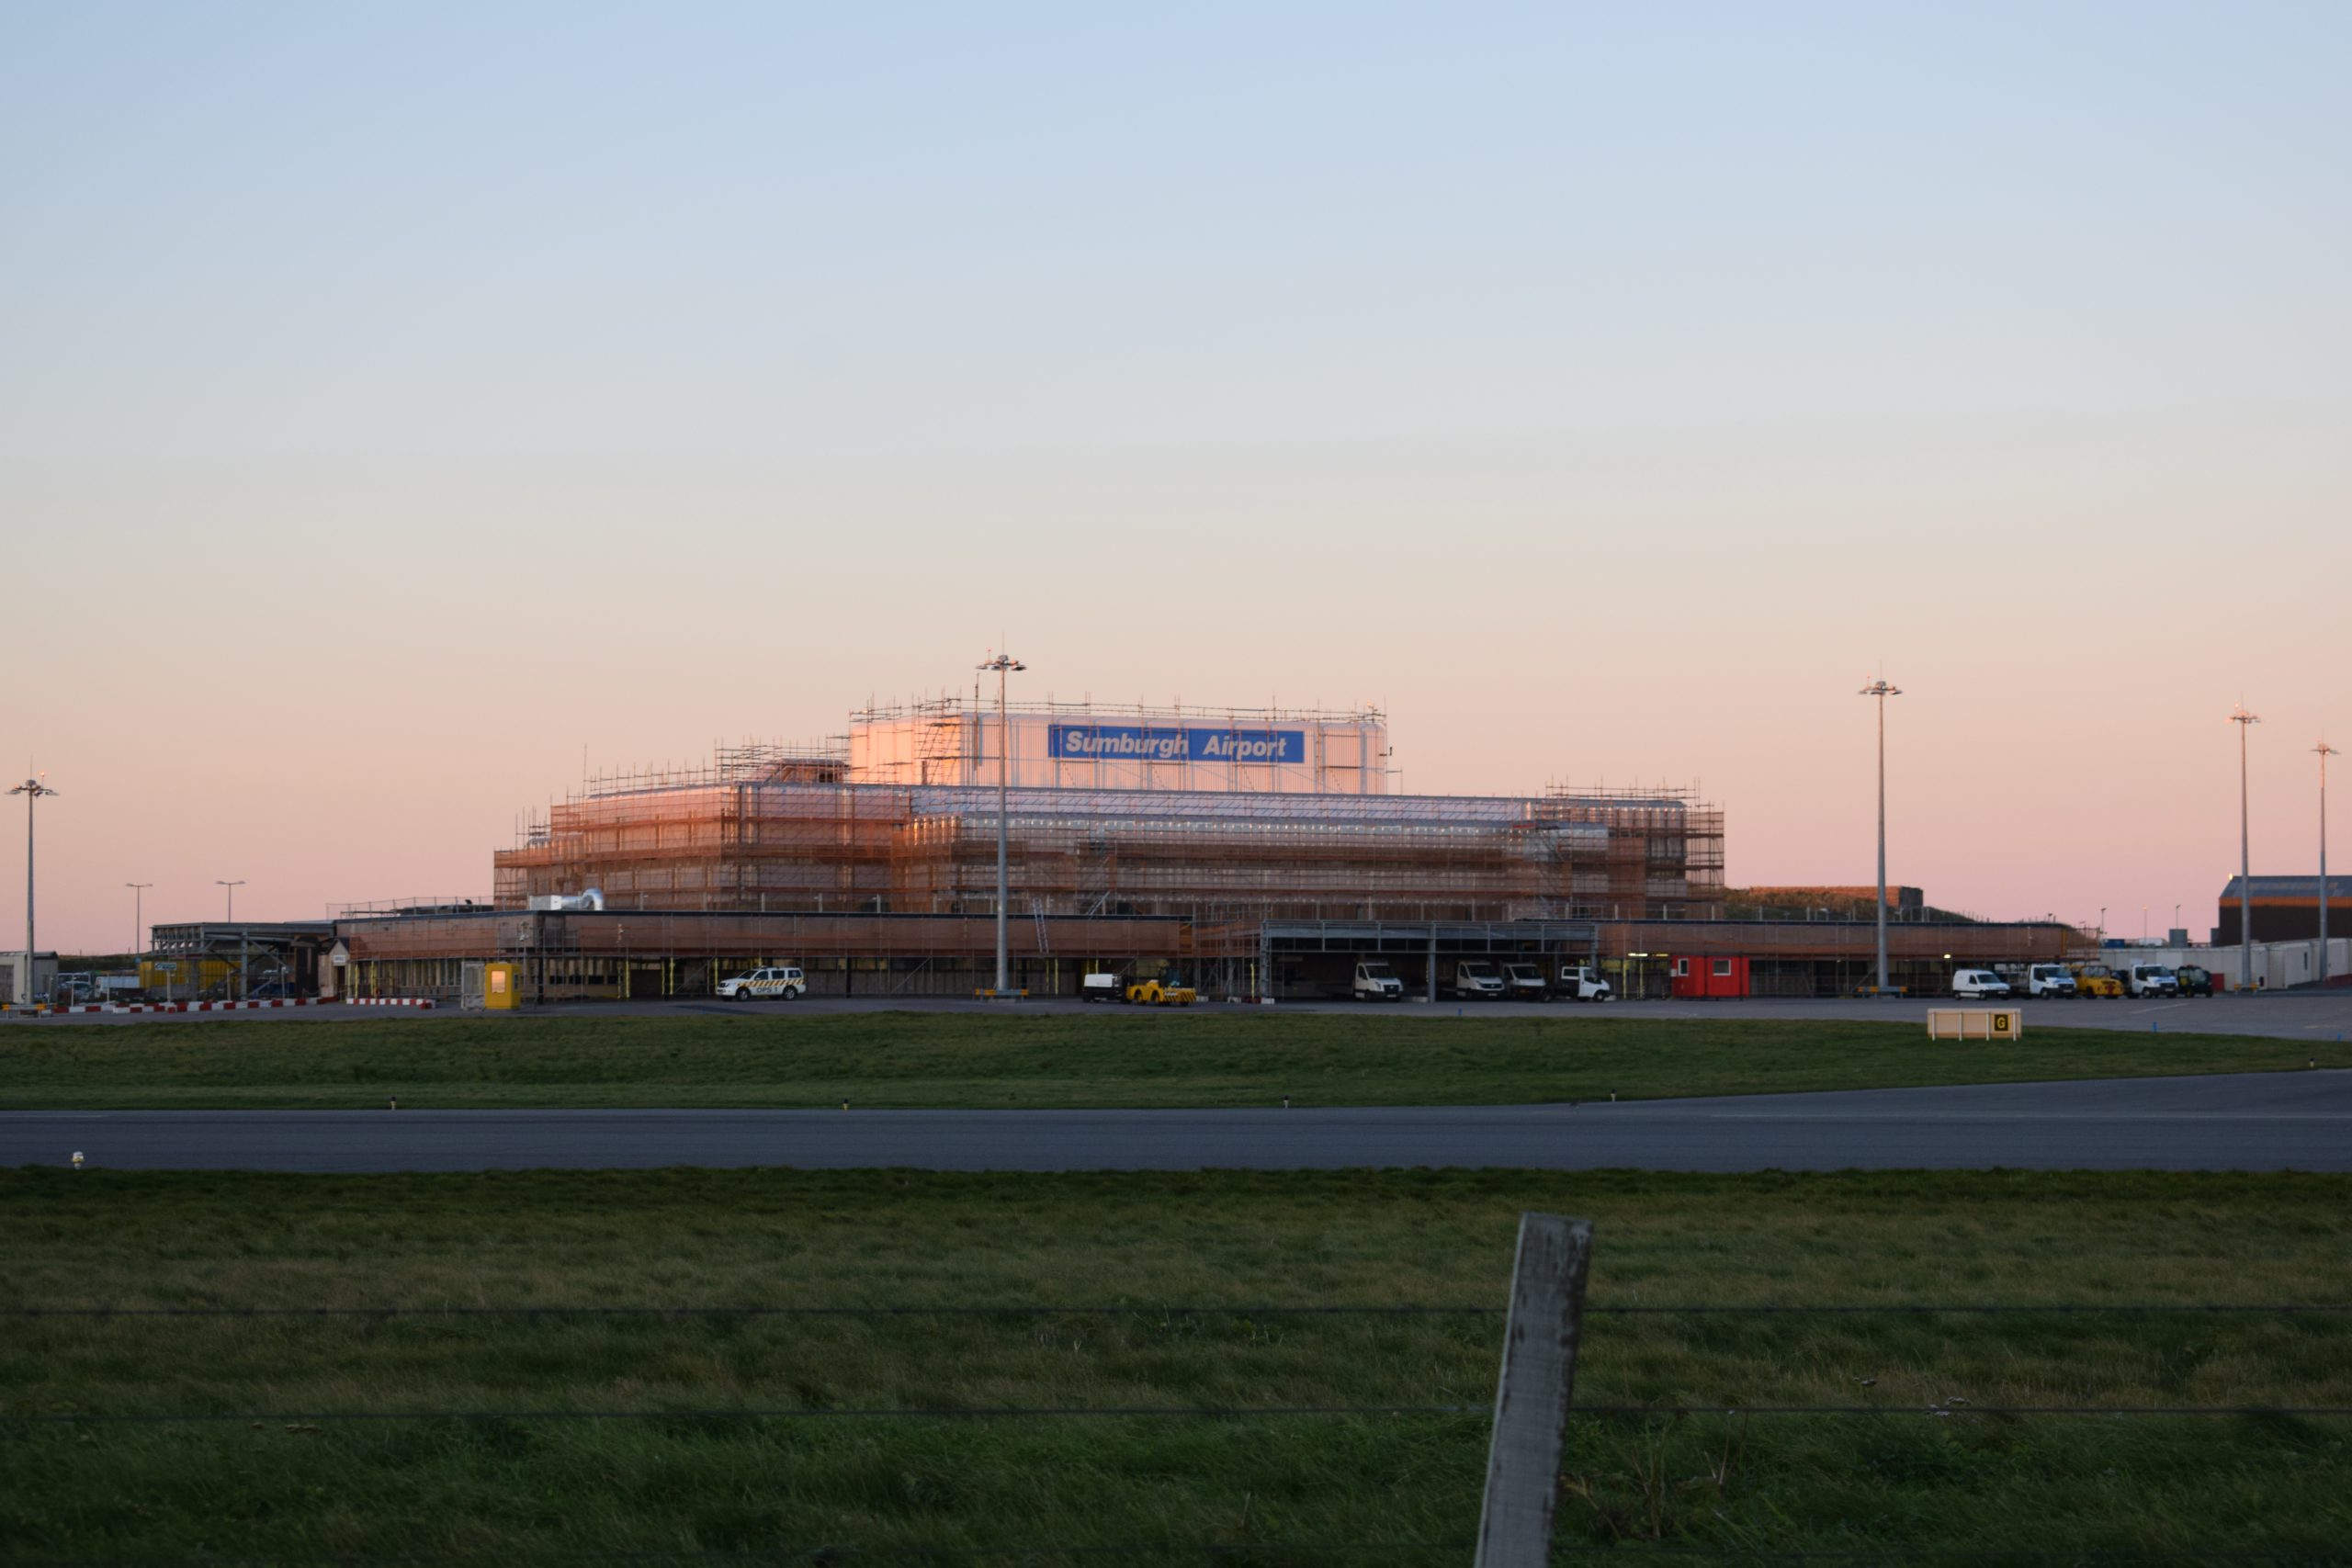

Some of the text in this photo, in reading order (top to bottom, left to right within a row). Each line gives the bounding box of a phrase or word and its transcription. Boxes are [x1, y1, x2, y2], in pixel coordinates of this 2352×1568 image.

[1066, 730, 1286, 761] Sumburgh Airport
[1996, 1017, 2006, 1029] G
